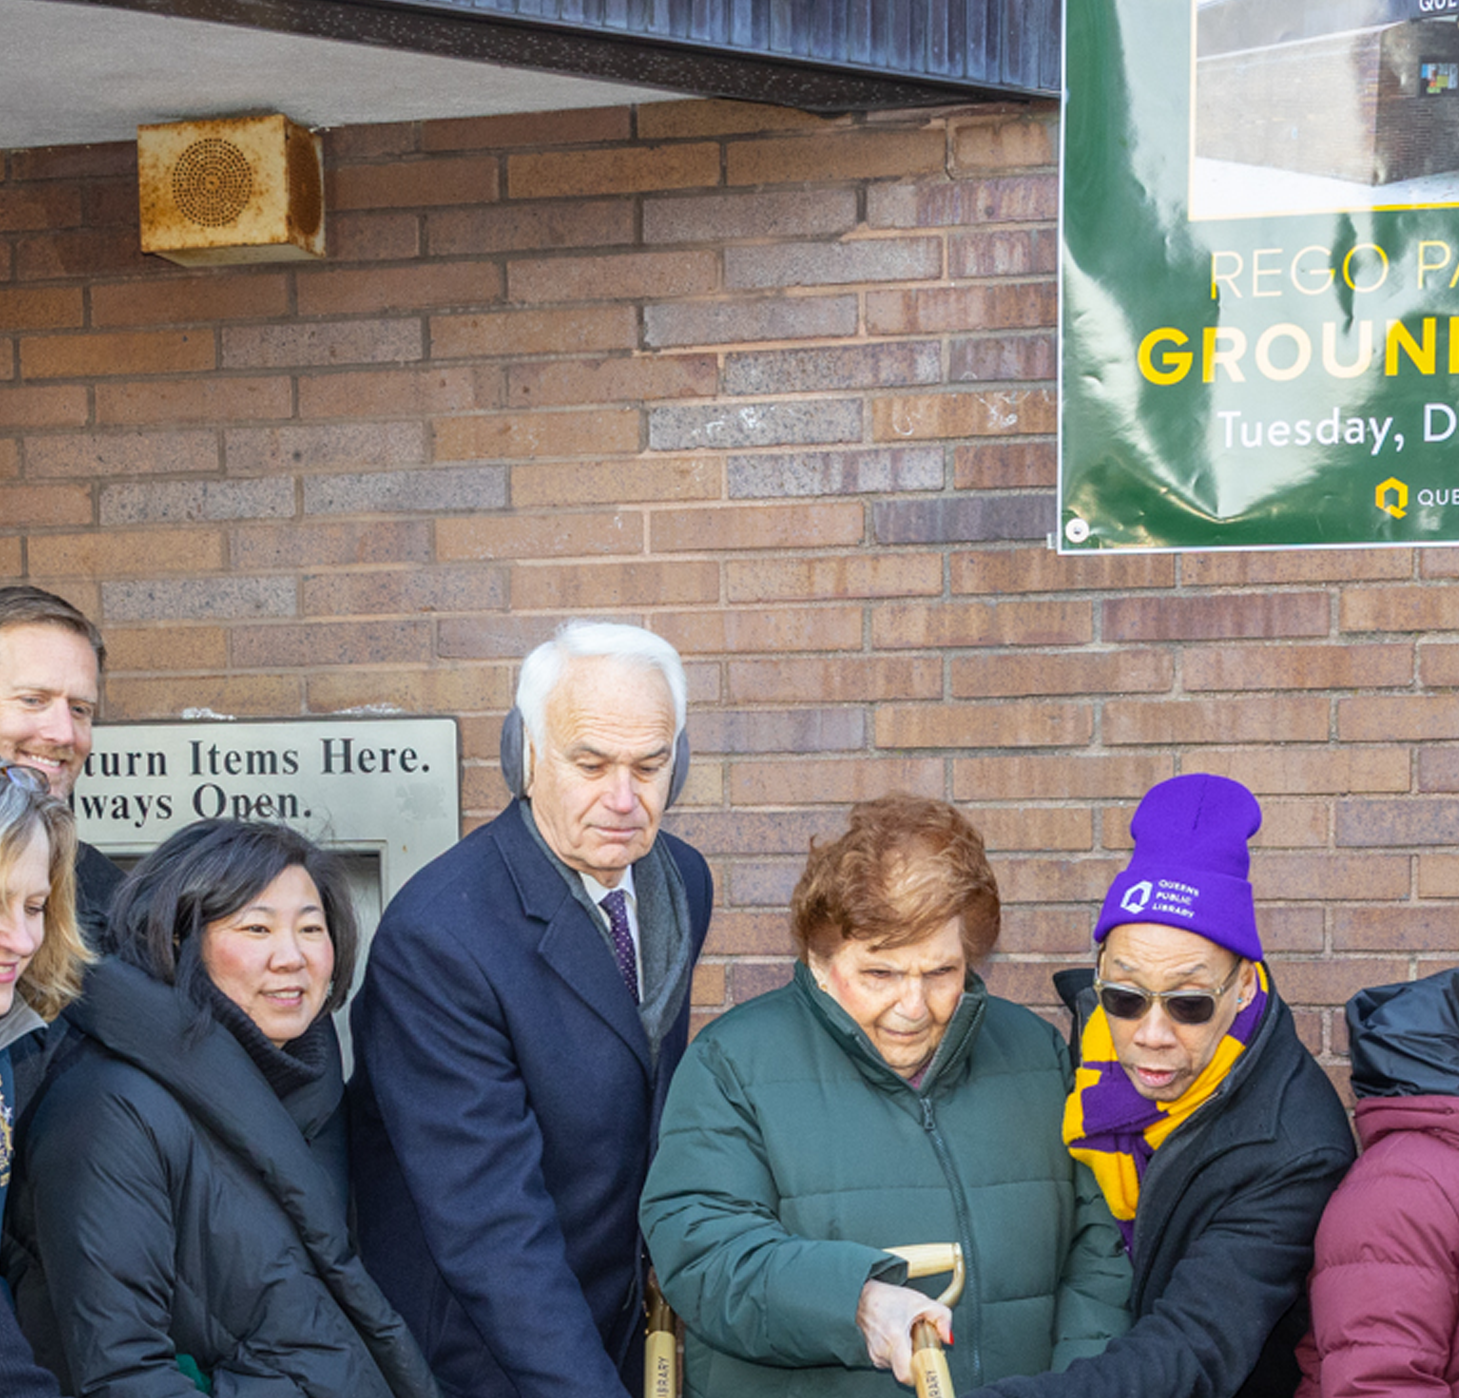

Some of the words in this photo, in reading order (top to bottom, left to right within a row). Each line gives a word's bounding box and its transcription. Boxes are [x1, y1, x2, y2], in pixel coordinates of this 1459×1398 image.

[1210, 243, 1390, 300] REGO
[1216, 406, 1406, 456] Tuesday,
[83, 746, 169, 778] turn
[188, 739, 301, 777] Items
[320, 738, 431, 774] Here.
[68, 787, 173, 828] lways
[192, 782, 313, 820] Open.
[1155, 890, 1193, 906] PUBLIC
[1157, 878, 1200, 898] QUEENS
[1151, 902, 1196, 919] LIBRARY
